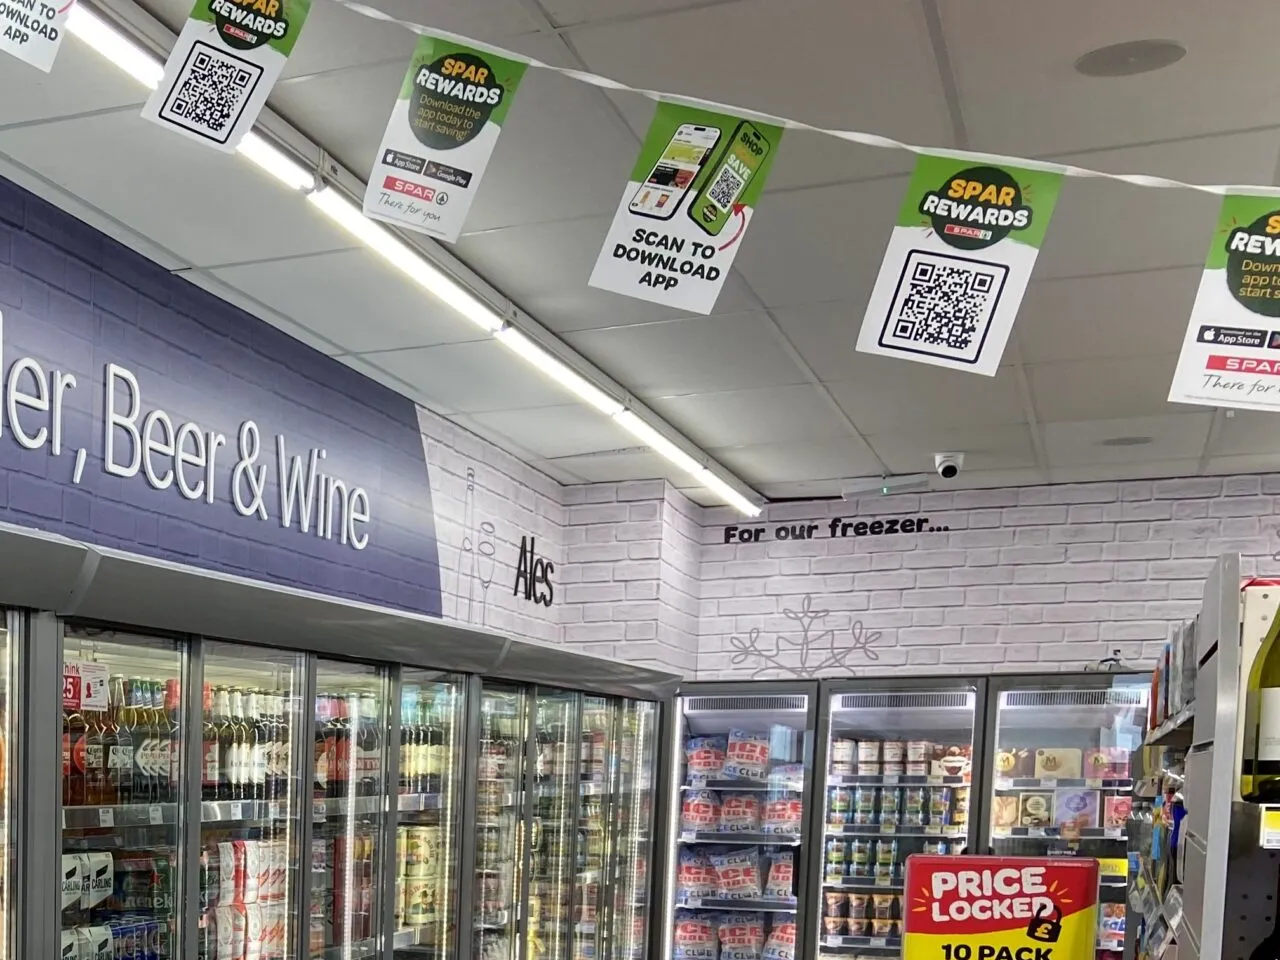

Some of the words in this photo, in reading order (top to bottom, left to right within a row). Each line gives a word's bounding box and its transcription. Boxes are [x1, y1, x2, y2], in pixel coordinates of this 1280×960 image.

[40, 3, 55, 20] TO
[211, 0, 286, 37] REWARDS
[3, 26, 29, 45] APP
[441, 58, 488, 84] SPAR
[416, 69, 500, 104] REWARDS
[417, 108, 435, 121] app
[436, 111, 464, 128] today
[465, 118, 474, 128] to
[420, 94, 464, 115] Download
[464, 106, 481, 119] the
[413, 119, 433, 132] start
[740, 132, 763, 157] SHOP
[394, 158, 406, 168] App
[406, 161, 420, 171] Store
[437, 169, 455, 182] Google
[455, 174, 467, 185] Play
[727, 154, 751, 181] SAVE
[394, 180, 434, 200] SPAR
[948, 179, 1016, 206] SPAR
[378, 192, 402, 209] There
[405, 202, 421, 215] for
[423, 210, 440, 222] you
[923, 195, 1029, 227] REWARDS
[632, 228, 685, 253] SCAN
[691, 242, 715, 260] TO
[613, 243, 720, 281] DOWNLOAD
[639, 271, 679, 291] APP
[1239, 286, 1271, 298] start
[1241, 274, 1269, 289] app
[1217, 335, 1235, 344] App
[1236, 335, 1260, 345] Store
[1202, 374, 1244, 390] There
[1247, 379, 1273, 396] for
[104, 361, 226, 504] Beer
[233, 419, 268, 520] &
[279, 433, 370, 550] Wine
[724, 525, 766, 544] For
[775, 522, 818, 541] our
[829, 515, 950, 538] freezer...
[514, 535, 554, 607] Ales
[92, 876, 112, 889] CARLING
[931, 867, 1047, 899] PRICE
[931, 896, 1054, 922] LOCKED
